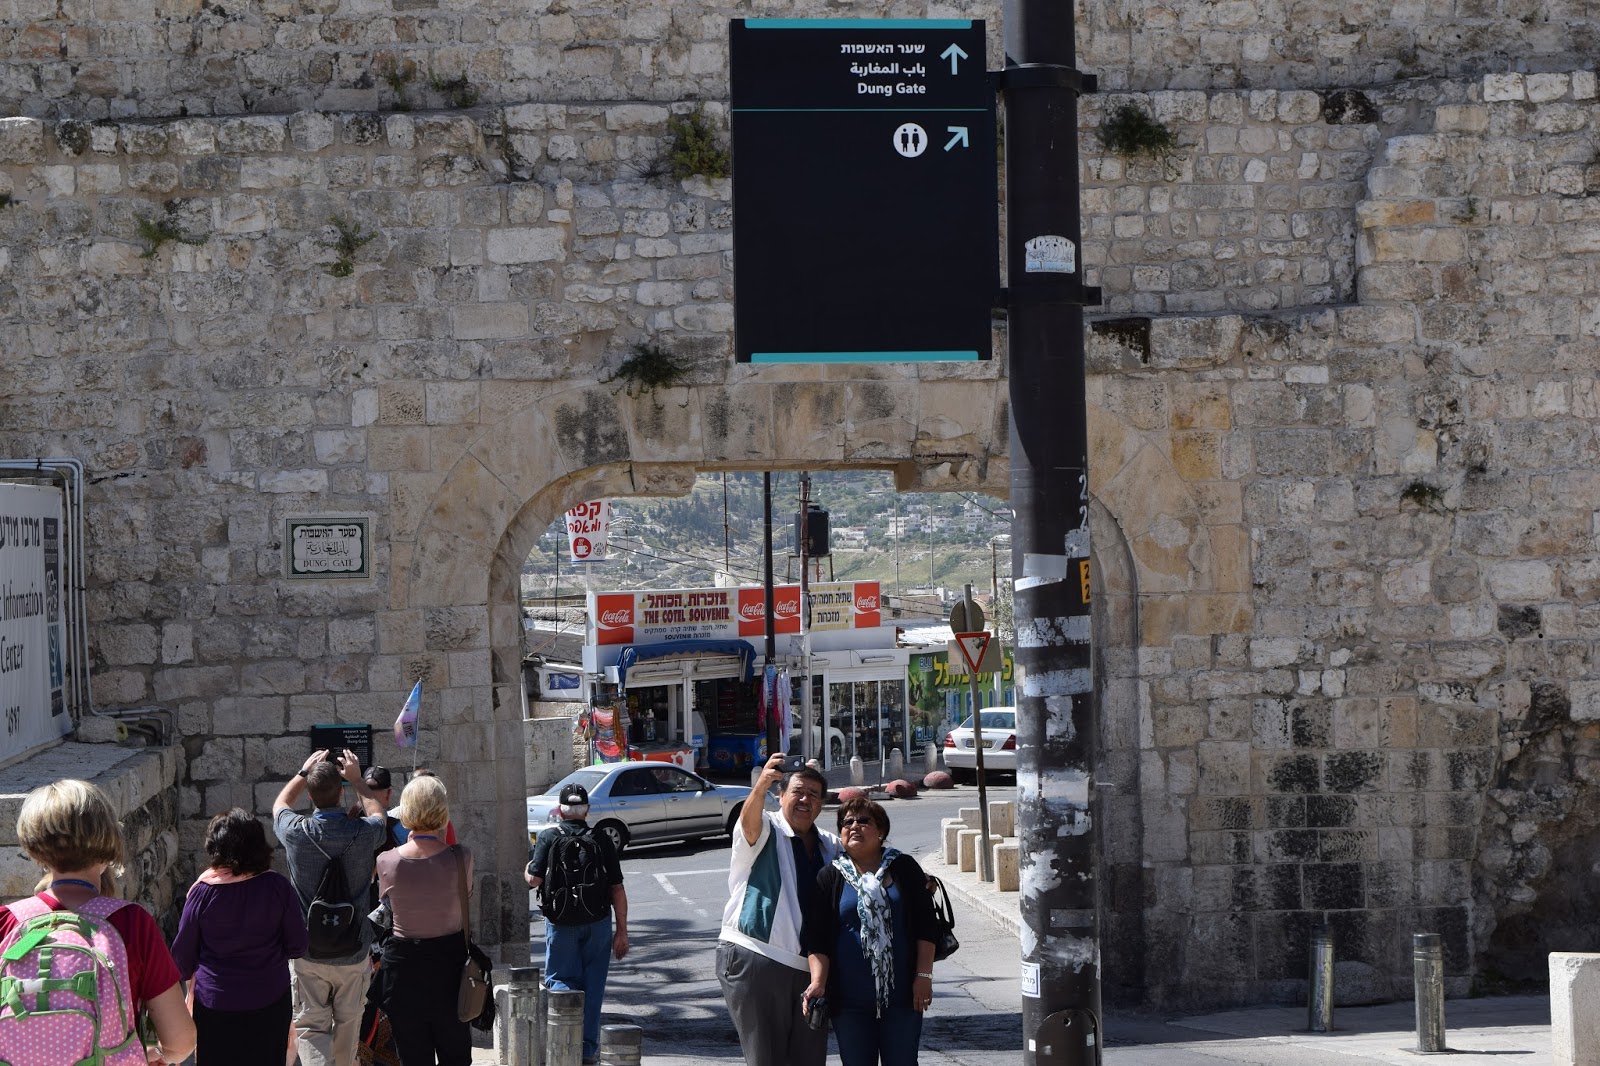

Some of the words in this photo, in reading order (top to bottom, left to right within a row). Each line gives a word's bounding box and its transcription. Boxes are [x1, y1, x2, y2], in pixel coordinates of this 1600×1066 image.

[840, 44, 894, 54] האשפות
[897, 44, 926, 54] שער
[849, 61, 900, 78] المغاربة
[902, 62, 926, 78] باب
[857, 82, 893, 97] Dung
[895, 82, 927, 94] Gate
[299, 528, 334, 539] האשפות
[338, 528, 357, 538] שער
[303, 560, 328, 569] DUNG
[332, 559, 355, 568] GATE
[3, 580, 44, 622] Information
[647, 594, 683, 609] הכותל
[687, 592, 728, 607] מזכרות
[835, 592, 852, 603] שתיה
[857, 595, 878, 609] Coca-Cola
[776, 600, 799, 614] Coca-Cola
[601, 609, 632, 624] Coca-Cola
[643, 610, 660, 625] THE
[662, 609, 687, 623] COTEL
[688, 607, 730, 622] SOUVENIR
[817, 611, 840, 623] מזכרות
[664, 633, 692, 641] SOUVENIR
[670, 627, 682, 635] קרה
[1, 635, 24, 674] Center
[919, 656, 934, 669] BLU
[915, 725, 935, 742] BLU
